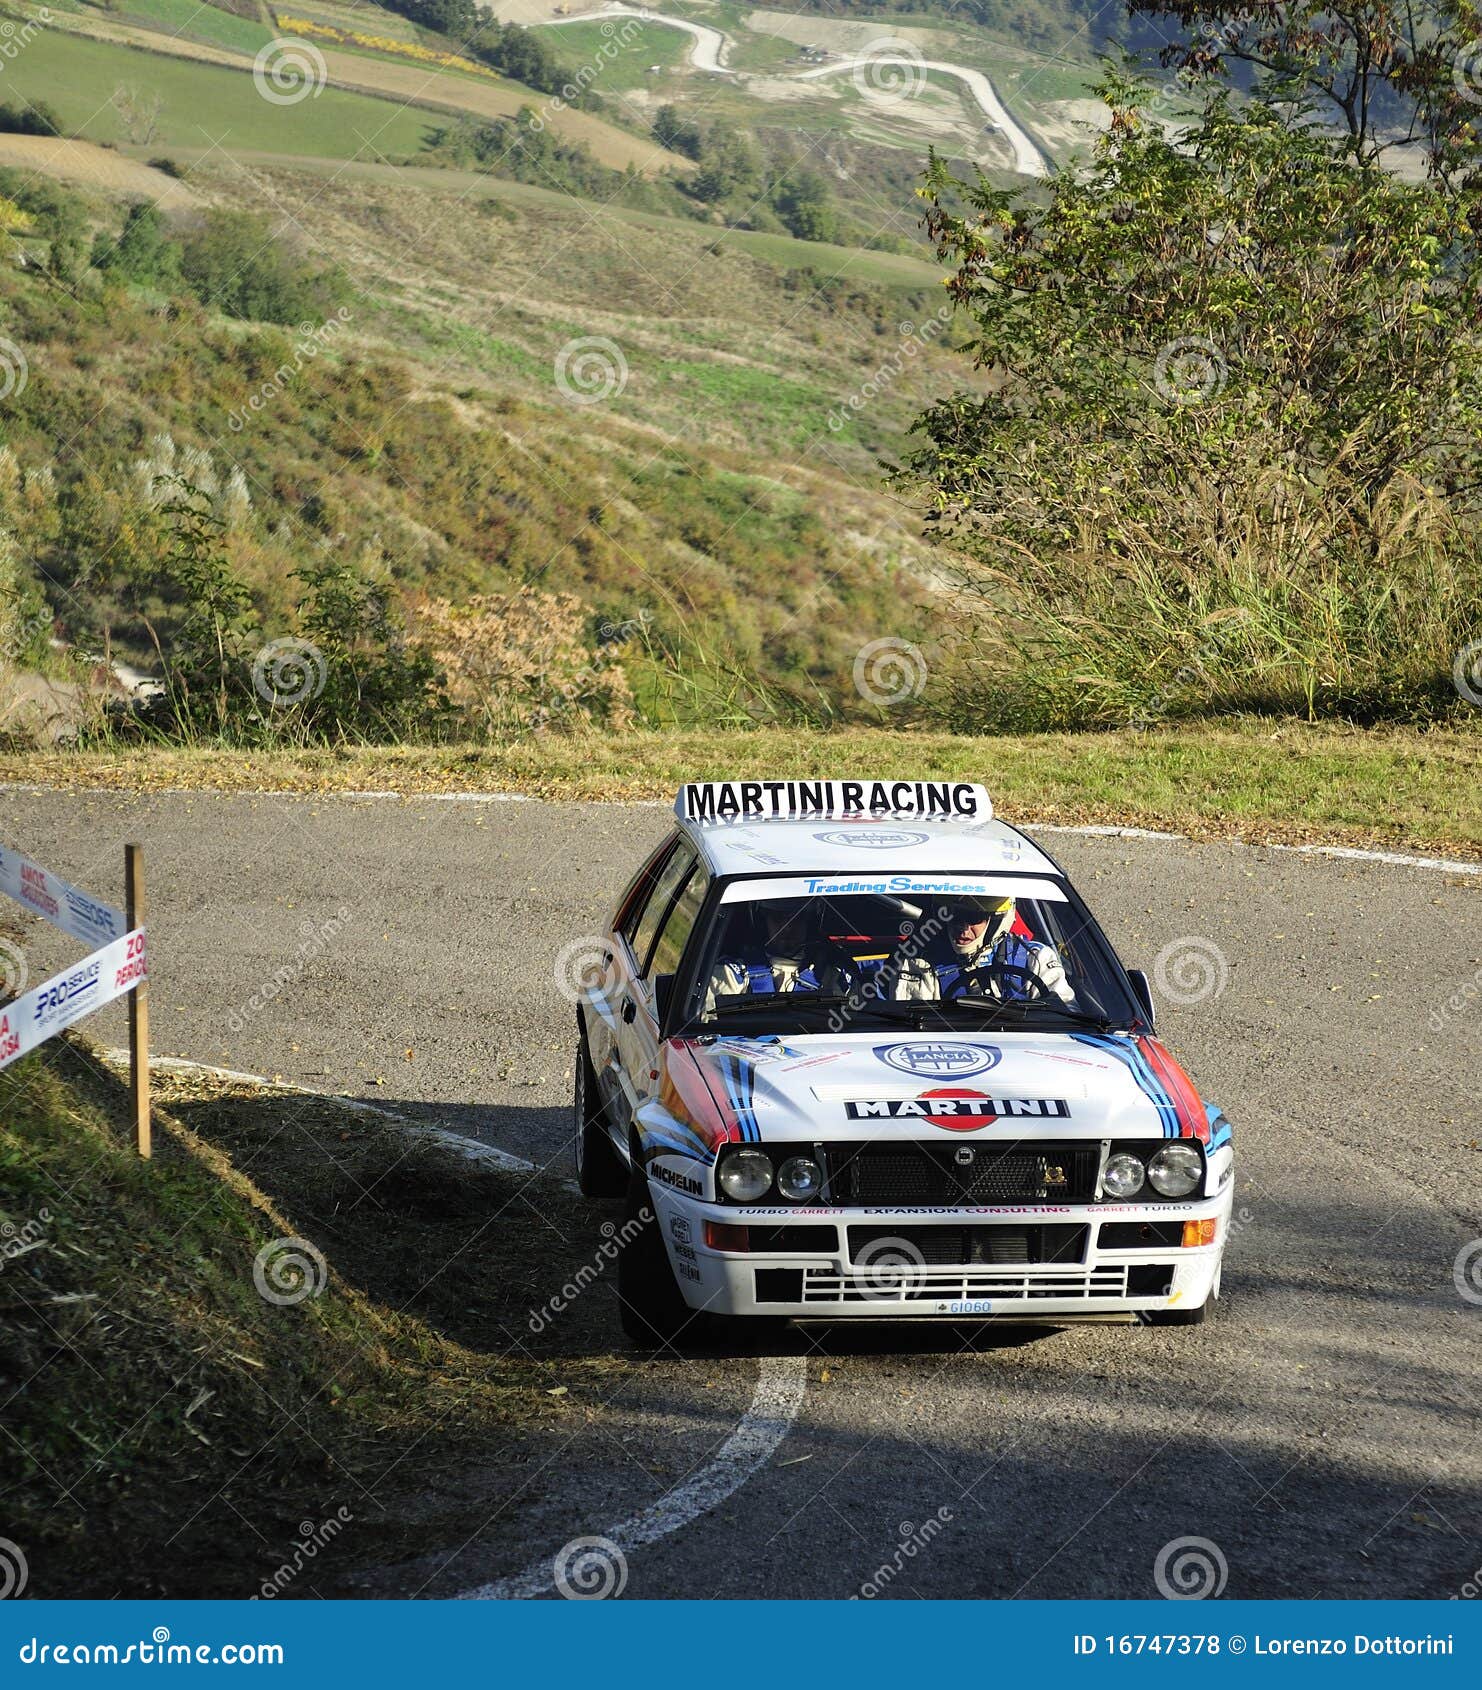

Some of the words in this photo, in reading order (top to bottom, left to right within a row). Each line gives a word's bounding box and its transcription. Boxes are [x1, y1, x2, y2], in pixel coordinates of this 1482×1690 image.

[687, 782, 834, 816] MARTINI
[842, 782, 977, 814] RACING
[803, 879, 886, 894] Trading
[888, 877, 986, 893] Services
[912, 1050, 972, 1062] LANCIA
[856, 1100, 1060, 1117] MARTINI
[650, 1162, 704, 1196] MICHELIN
[964, 1206, 1071, 1214] CONSULTING
